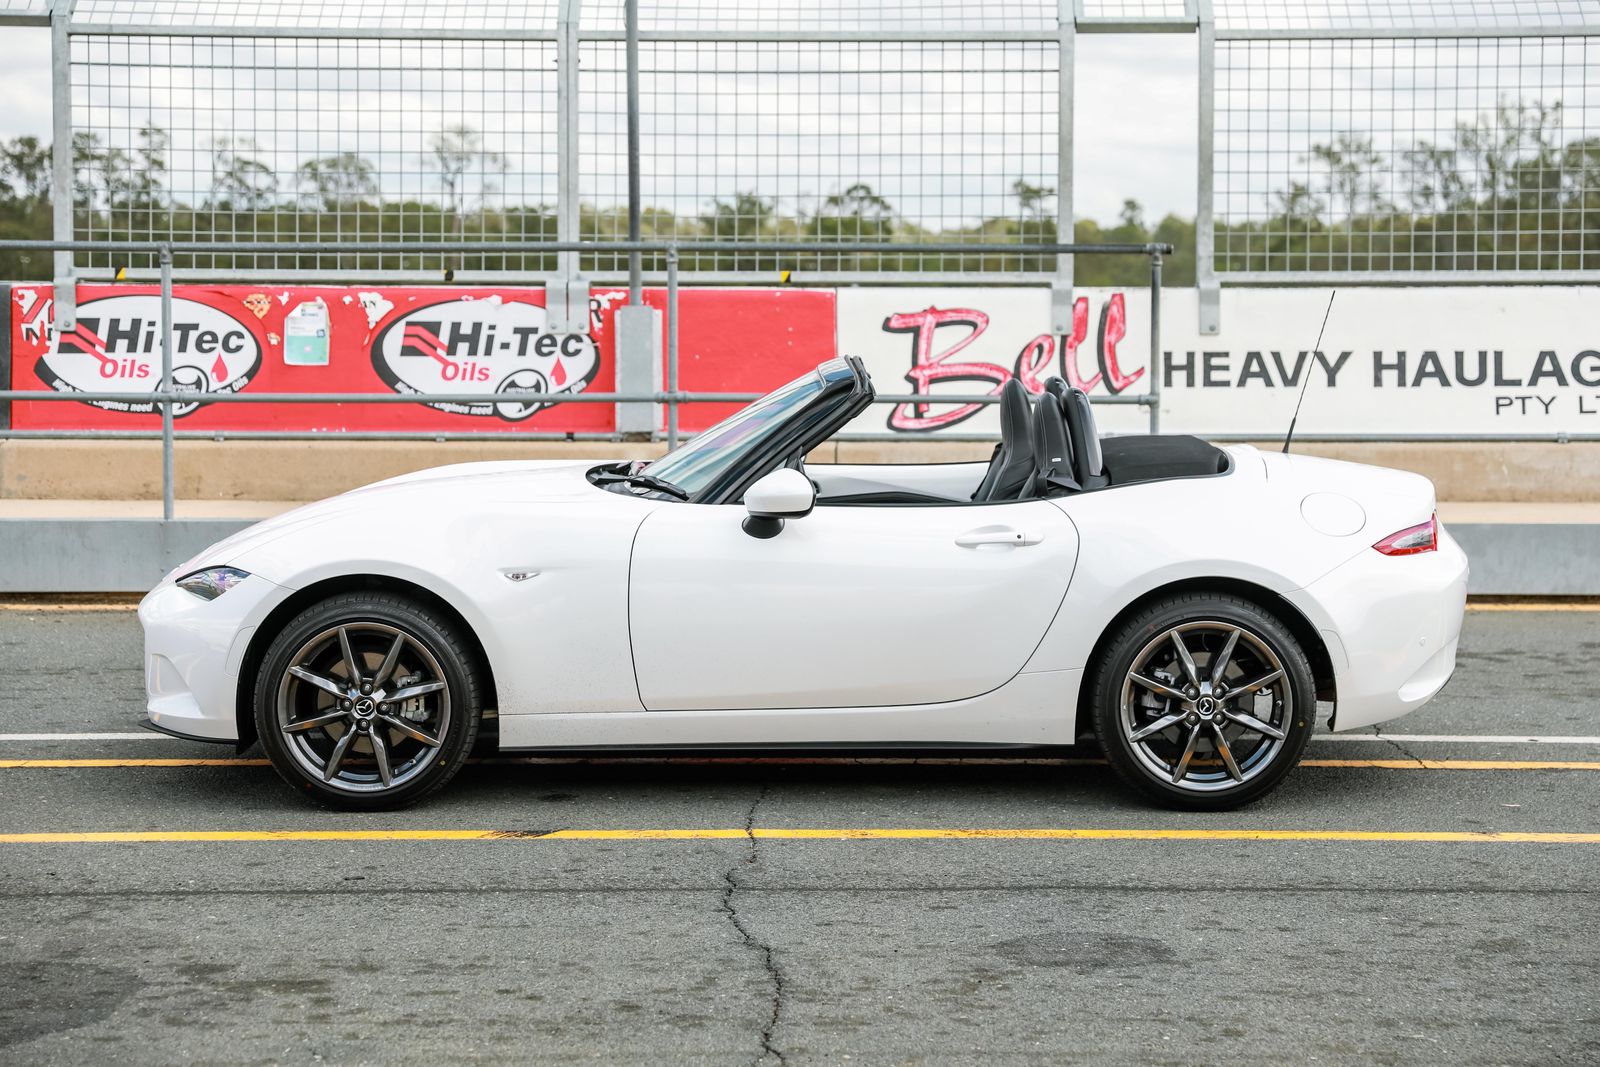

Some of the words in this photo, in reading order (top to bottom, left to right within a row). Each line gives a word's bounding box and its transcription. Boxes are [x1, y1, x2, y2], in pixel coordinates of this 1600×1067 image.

[105, 318, 245, 353] HiTec
[446, 321, 584, 357] Hi-Tec
[99, 357, 150, 379] Oils
[440, 361, 490, 382] Oils
[882, 293, 1145, 432] Bell
[1163, 350, 1353, 388] HEAVY
[1373, 350, 1600, 388] HAULAG
[1495, 395, 1557, 415] PTY
[1579, 395, 1600, 414] L
